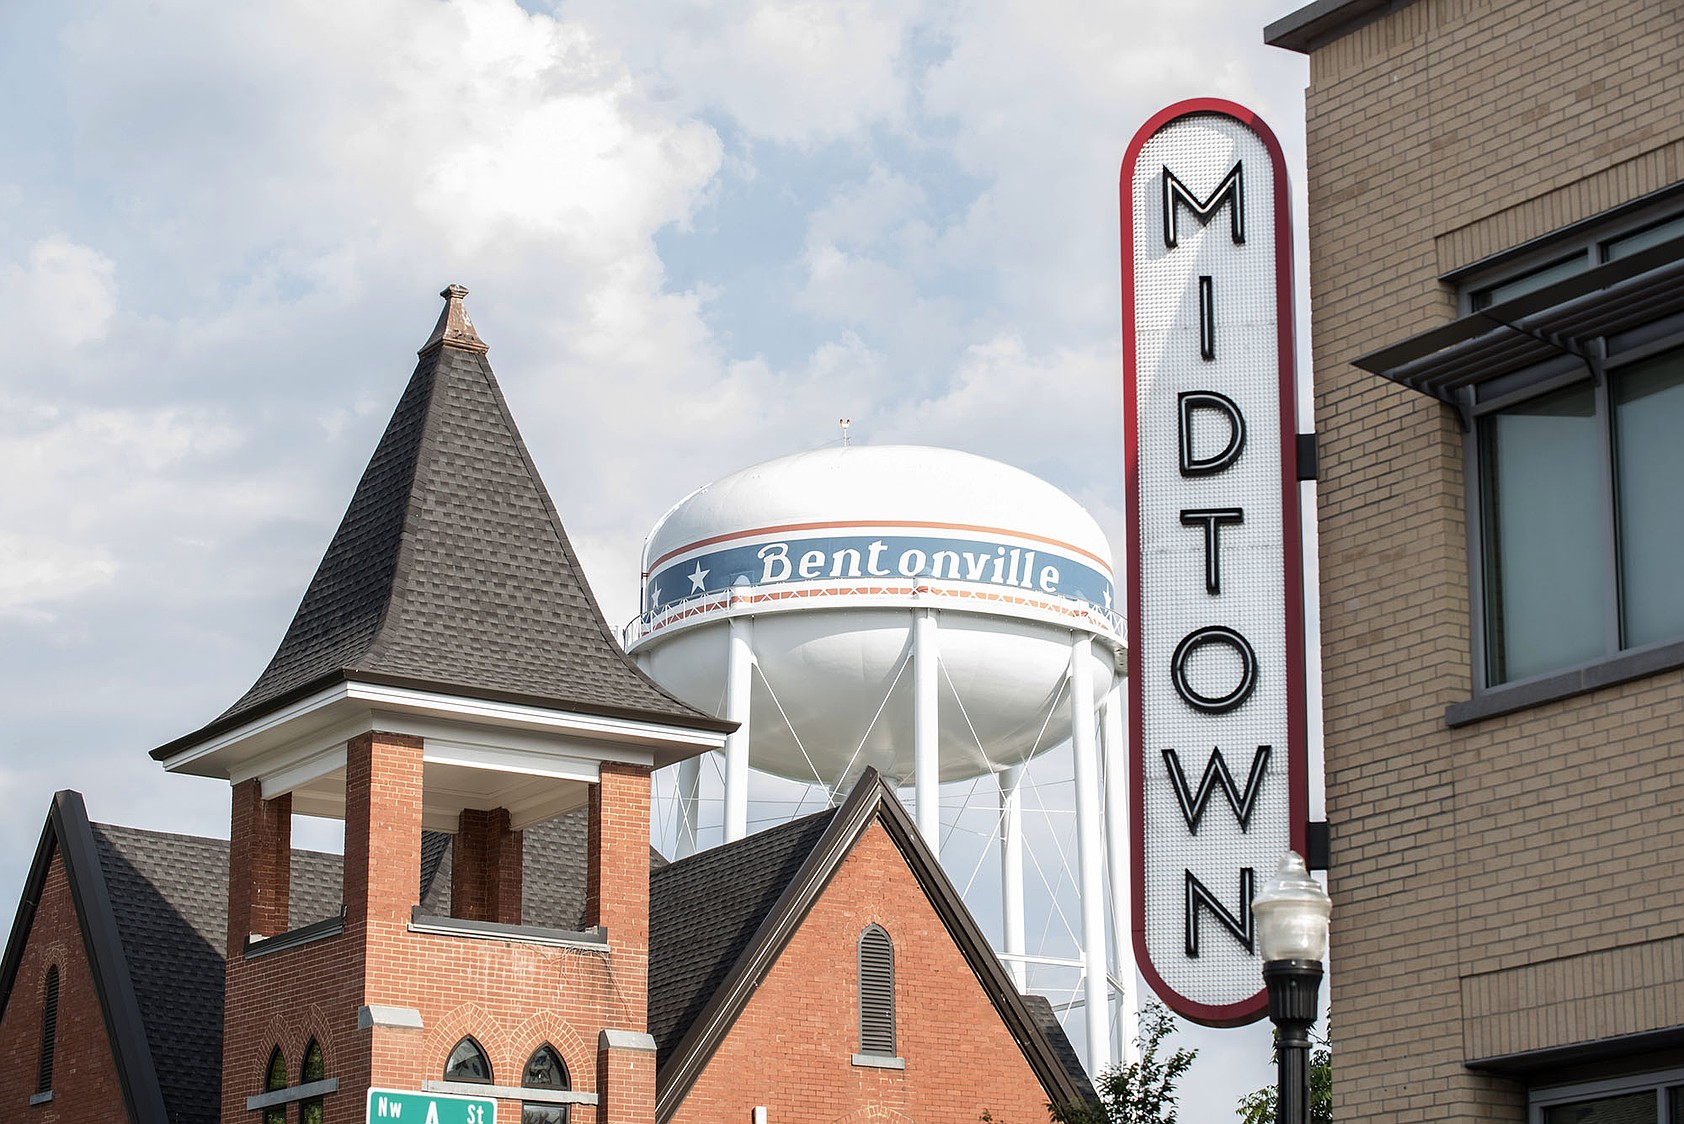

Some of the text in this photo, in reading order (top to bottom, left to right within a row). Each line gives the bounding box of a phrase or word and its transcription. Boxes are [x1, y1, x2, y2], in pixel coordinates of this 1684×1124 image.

[757, 540, 1061, 592] Bentonville
[1161, 159, 1272, 957] MIDTOWN
[425, 1101, 440, 1124] A
[466, 1104, 484, 1124] St
